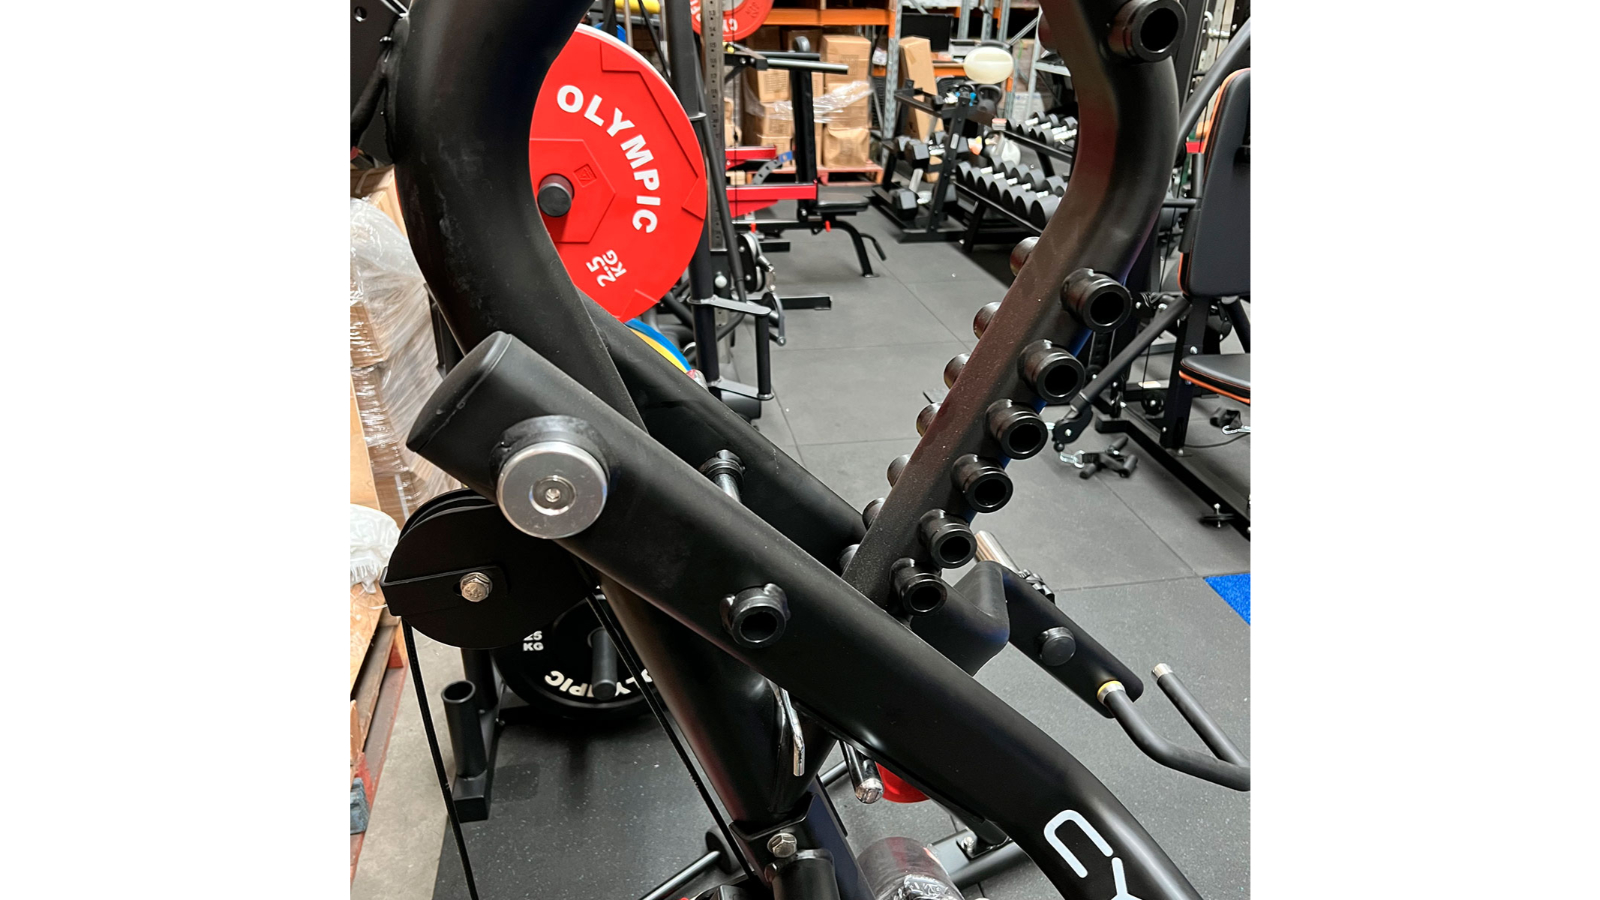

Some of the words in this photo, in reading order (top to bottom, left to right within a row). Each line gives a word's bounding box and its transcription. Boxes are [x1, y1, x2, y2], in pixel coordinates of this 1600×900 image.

[556, 85, 661, 234] OLYMPIC
[602, 249, 627, 278] KG
[522, 642, 544, 652] KG
